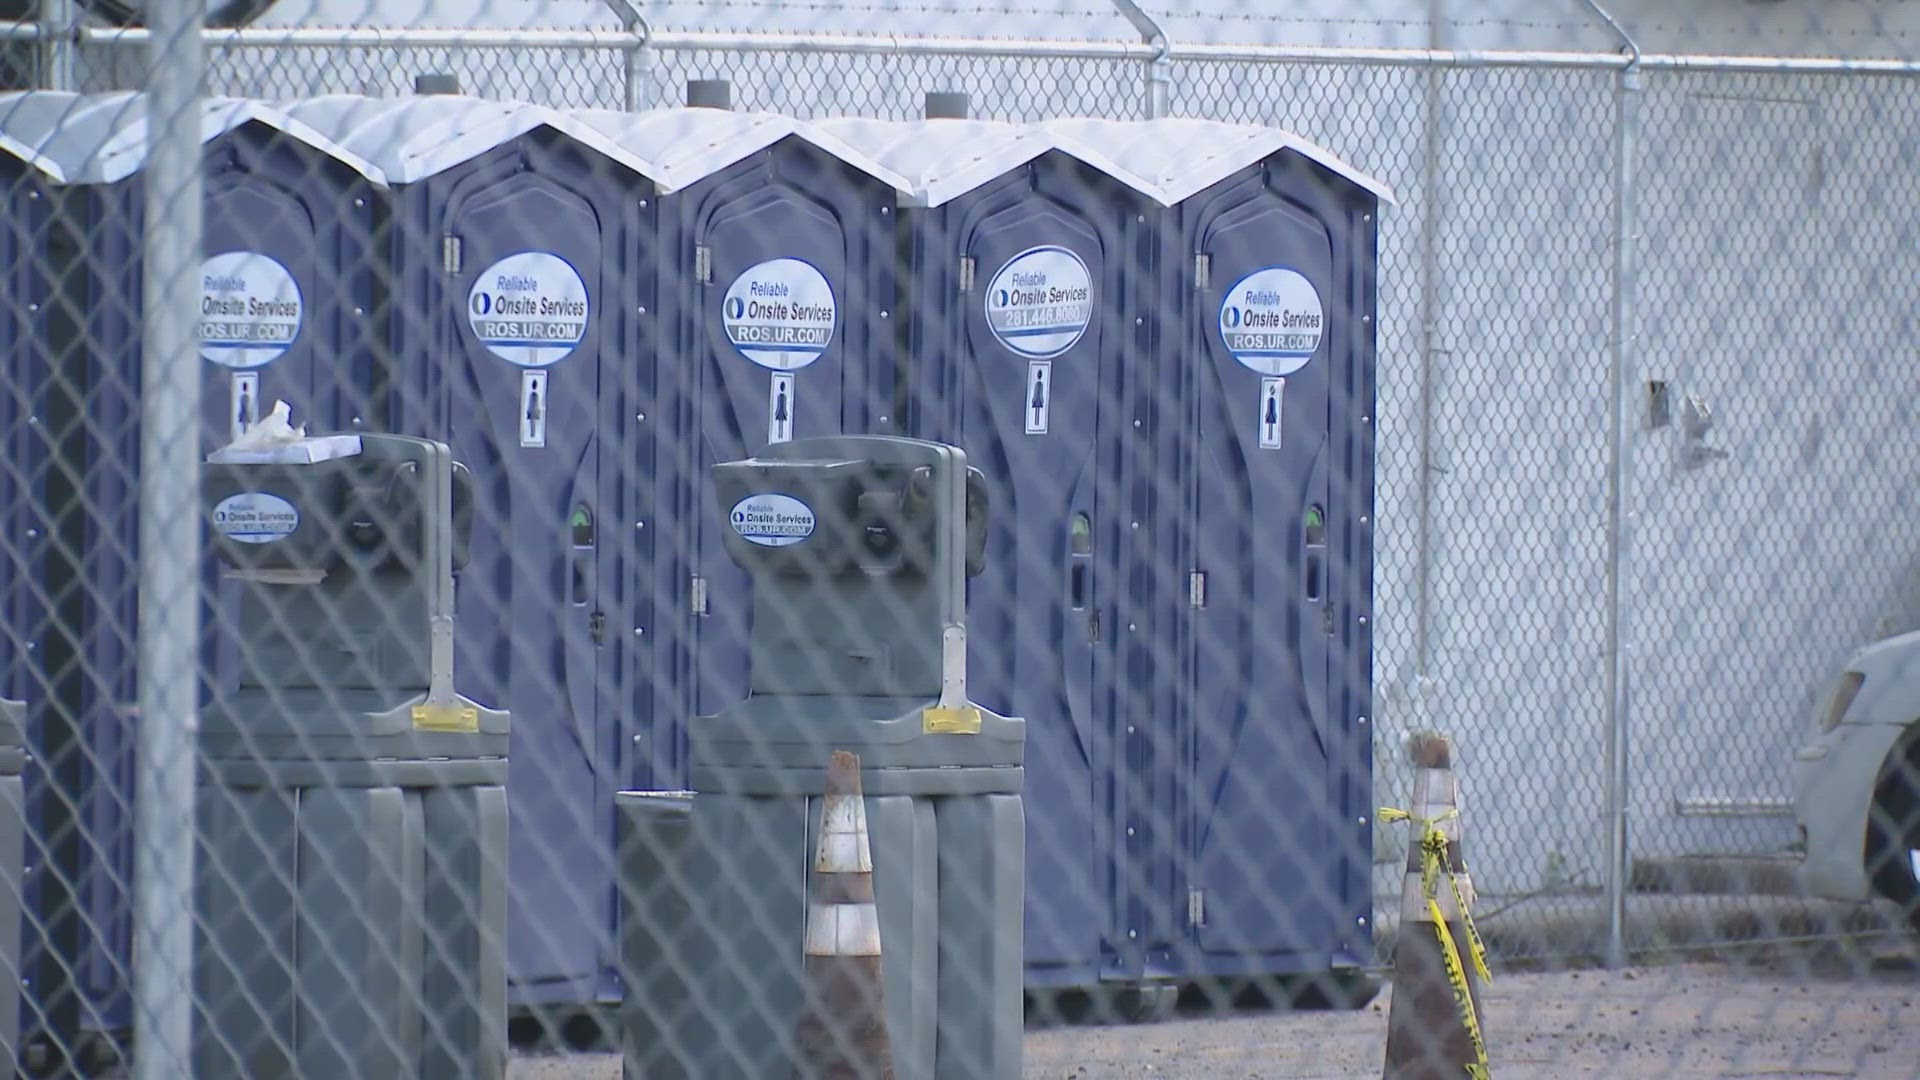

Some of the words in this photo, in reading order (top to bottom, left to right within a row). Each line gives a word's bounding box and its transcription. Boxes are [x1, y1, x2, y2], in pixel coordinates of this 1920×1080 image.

[496, 275, 538, 291] Reliable
[1012, 272, 1046, 287] Reliable
[750, 281, 788, 297] Reliable
[1011, 288, 1046, 306] Onsite
[1049, 285, 1088, 303] Services
[495, 295, 537, 315] Onsite
[540, 296, 585, 316] Services
[1245, 291, 1280, 305] Reliable
[202, 296, 245, 316] Onsite
[248, 297, 298, 317] Services
[748, 300, 788, 320] Onsite
[791, 302, 832, 322] Services
[1243, 309, 1279, 328] Onsite
[1282, 309, 1320, 328] Services
[485, 322, 577, 338] ROS.UR.COM
[737, 327, 825, 343] ROS.UR.COM
[1233, 335, 1314, 349] ROS.UR.COM
[258, 512, 295, 521] Services
[746, 513, 774, 524] Onsite
[776, 513, 812, 525] Services
